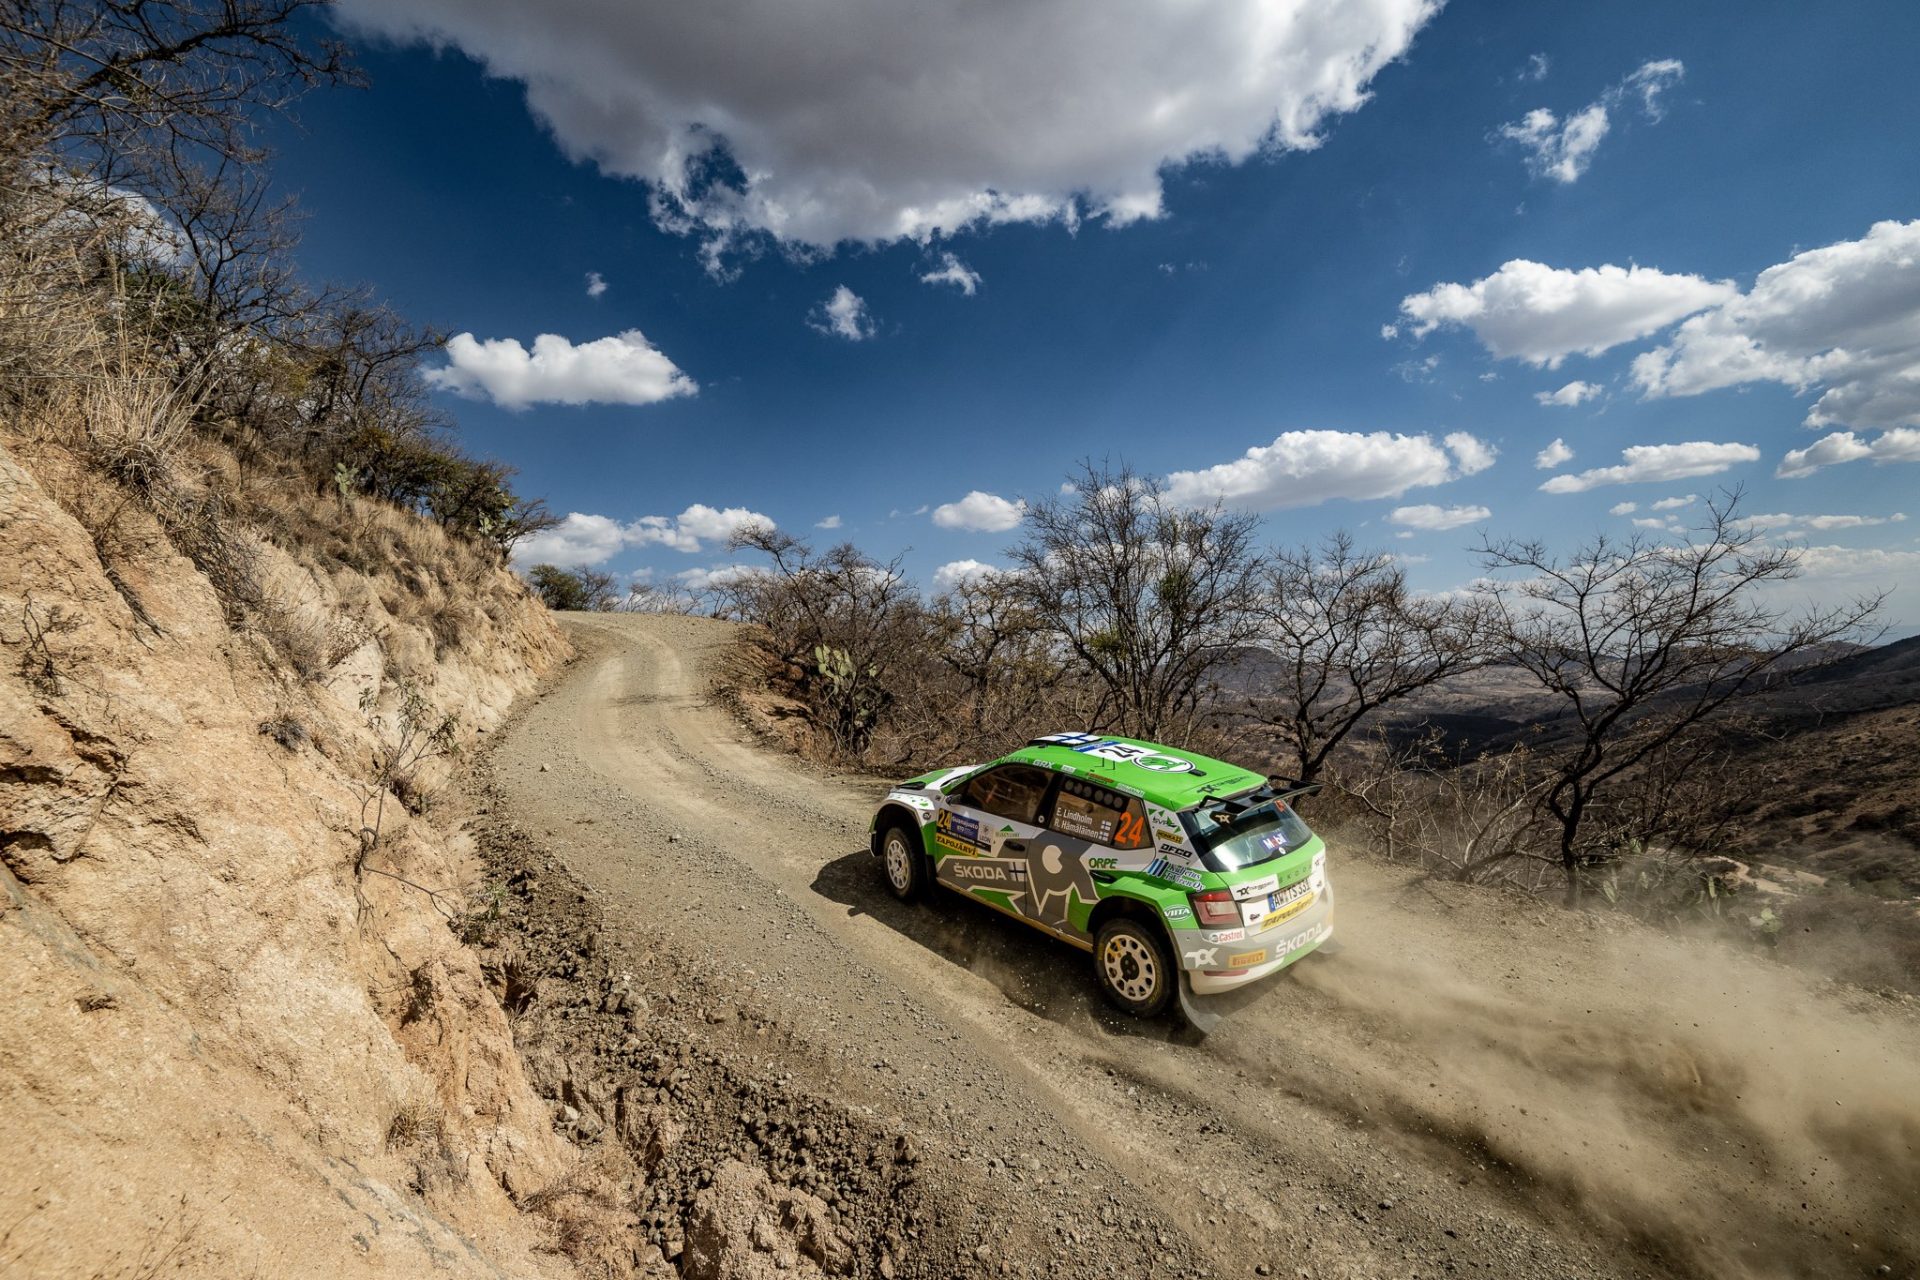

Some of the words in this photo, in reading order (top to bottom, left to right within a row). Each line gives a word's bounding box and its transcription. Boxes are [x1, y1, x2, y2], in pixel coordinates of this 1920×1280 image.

[1099, 745, 1144, 759] 24
[937, 808, 952, 830] 24
[1056, 807, 1062, 816] E.
[1063, 809, 1093, 825] Lindholm
[1054, 818, 1060, 828] R.
[1061, 820, 1099, 839] Hämäläinen
[1114, 811, 1145, 849] 24
[953, 862, 1007, 880] ŠKODA
[1088, 857, 1118, 869] ORPE
[1218, 930, 1243, 943] Castrol
[1275, 922, 1322, 959] ŠKODA
[1232, 951, 1263, 966] PIRELLI
